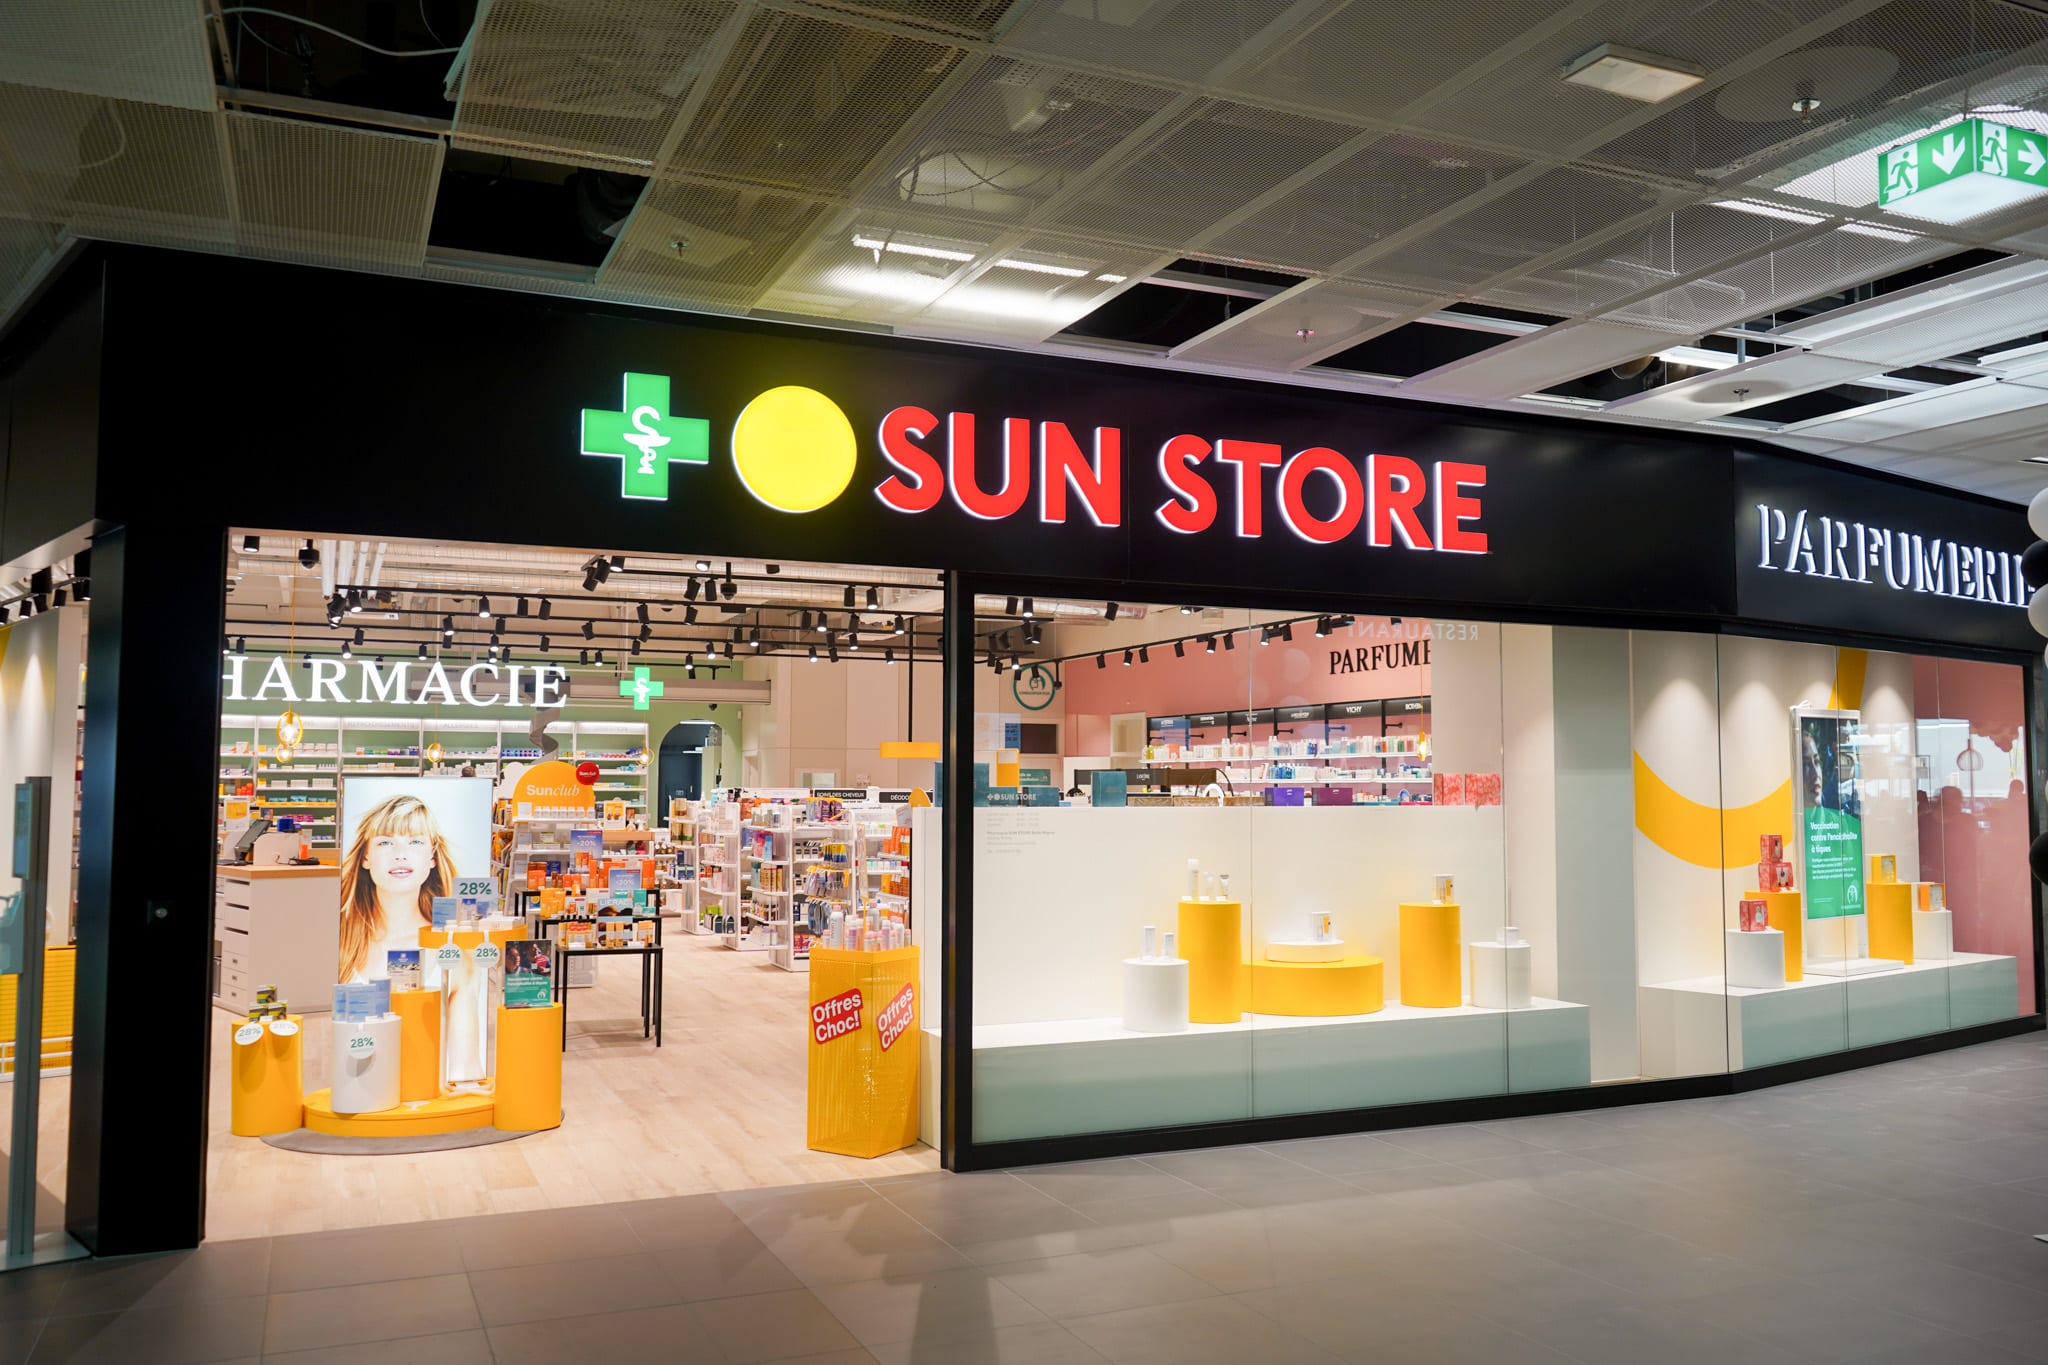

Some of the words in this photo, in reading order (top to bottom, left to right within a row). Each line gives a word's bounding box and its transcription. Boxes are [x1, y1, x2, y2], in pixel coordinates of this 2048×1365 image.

[874, 405, 1122, 528] SUN
[1155, 433, 1490, 555] STORE
[1345, 705, 1363, 713] VICHY
[527, 784, 579, 796] Sunclub
[458, 882, 492, 896] 28%
[438, 948, 461, 959] 28%
[475, 947, 498, 958] 28%
[813, 993, 861, 1023] Offres
[878, 988, 912, 1031] Offres
[239, 1028, 261, 1037] 28%
[815, 1011, 860, 1042] Choc!
[882, 1005, 912, 1049] Choc!
[350, 1037, 374, 1049] 28%
